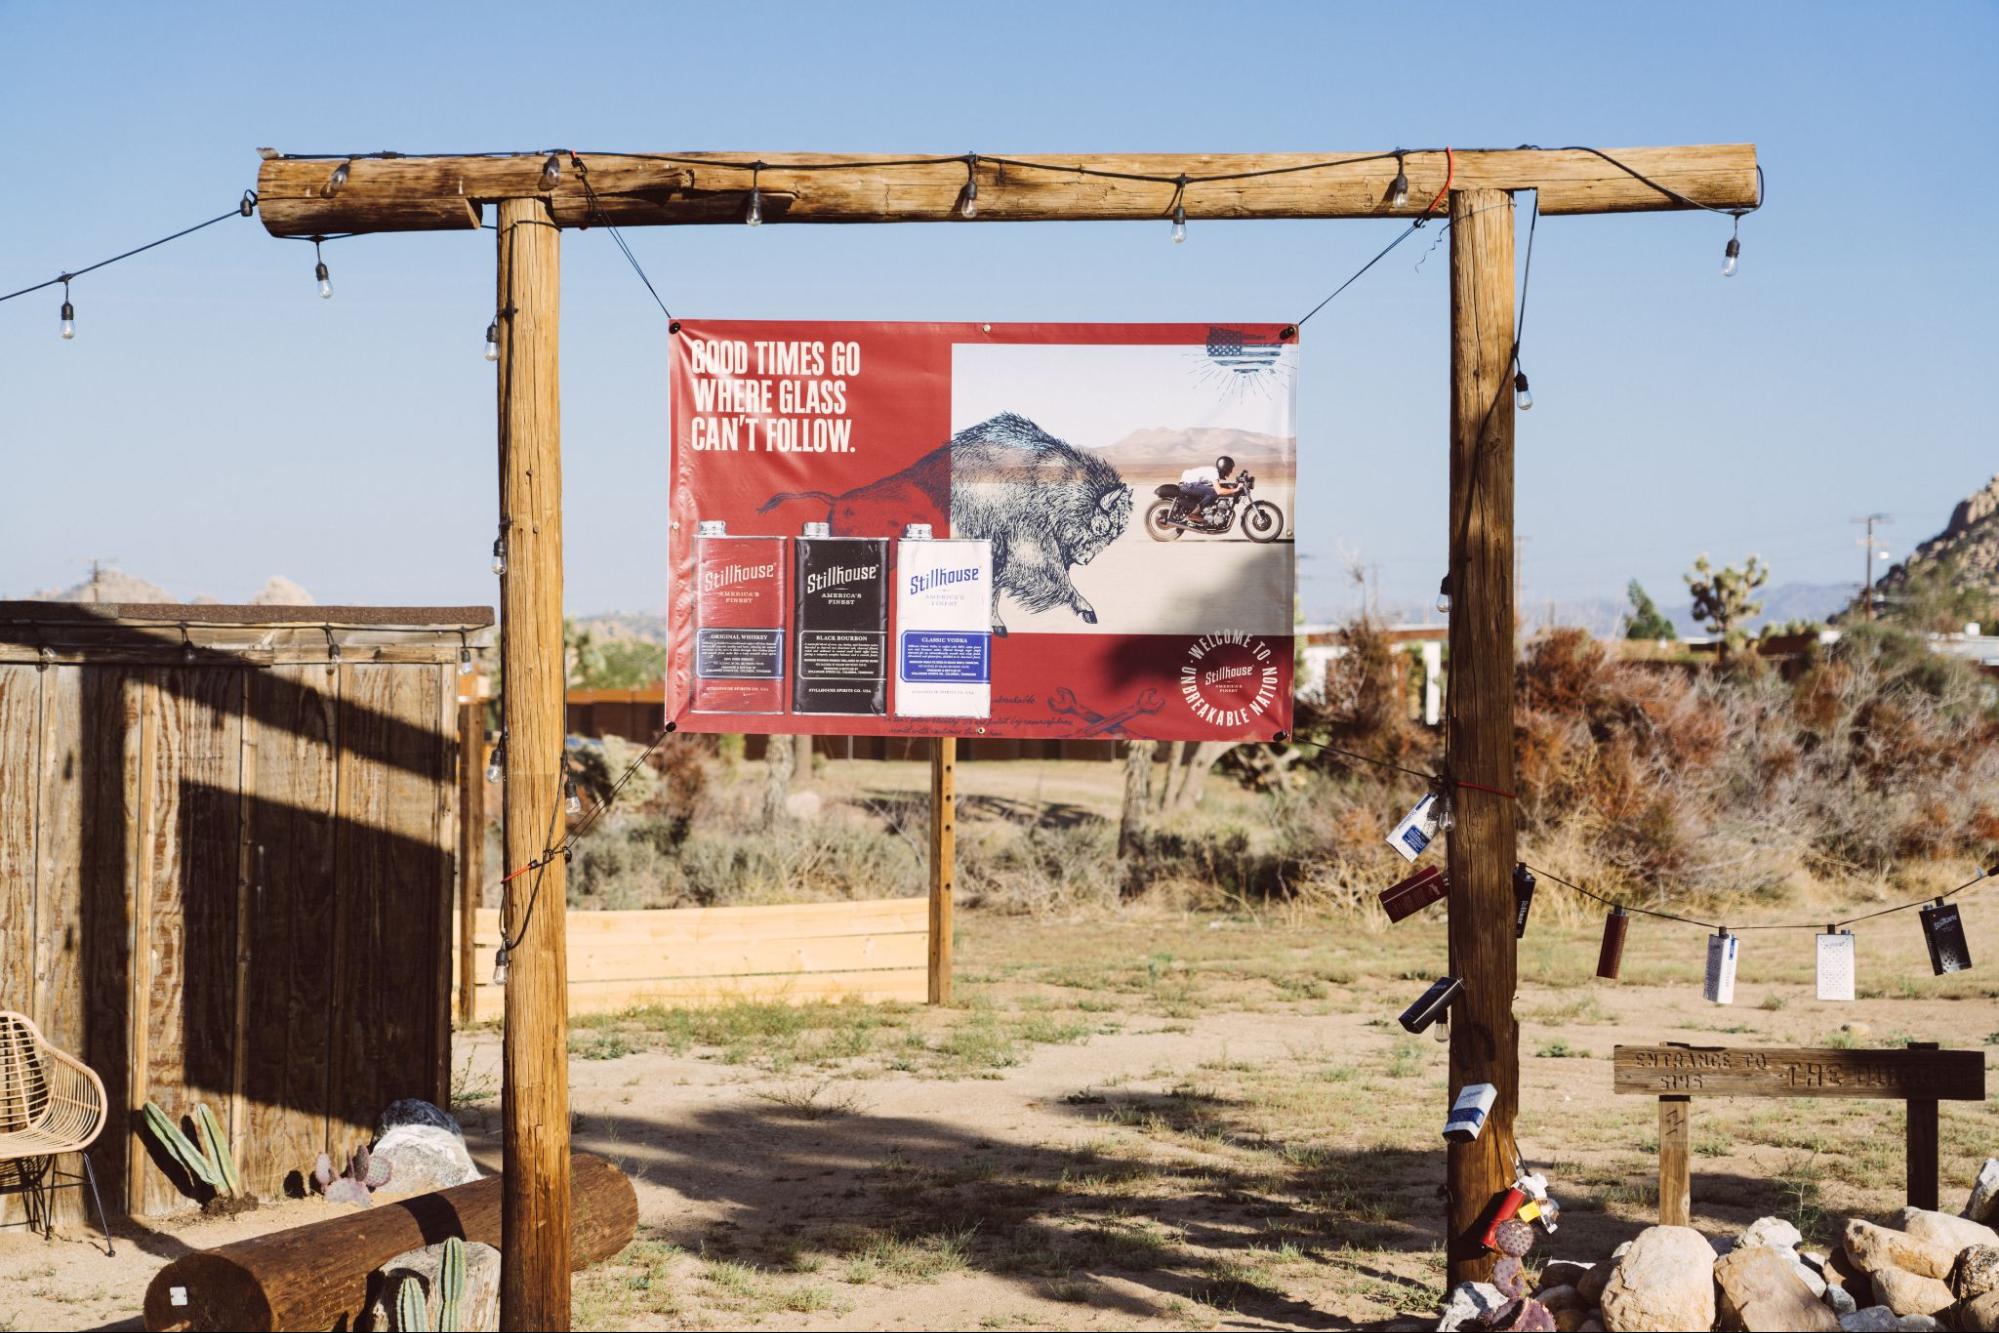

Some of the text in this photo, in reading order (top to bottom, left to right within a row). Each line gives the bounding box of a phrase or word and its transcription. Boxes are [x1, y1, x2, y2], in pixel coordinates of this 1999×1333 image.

[691, 340, 861, 377] GOOD TIMES GO
[692, 378, 847, 414] WHERE GLASS
[691, 414, 856, 453] CAN'T FOLLOW.
[704, 564, 774, 593] Stillhouse
[807, 565, 877, 595] Stillhouse
[910, 567, 979, 596] Stillhouse
[1188, 628, 1272, 661] WELCOME TO
[1205, 665, 1254, 686] Stillhouse
[1181, 666, 1279, 727] UNBREAKABLE NATION
